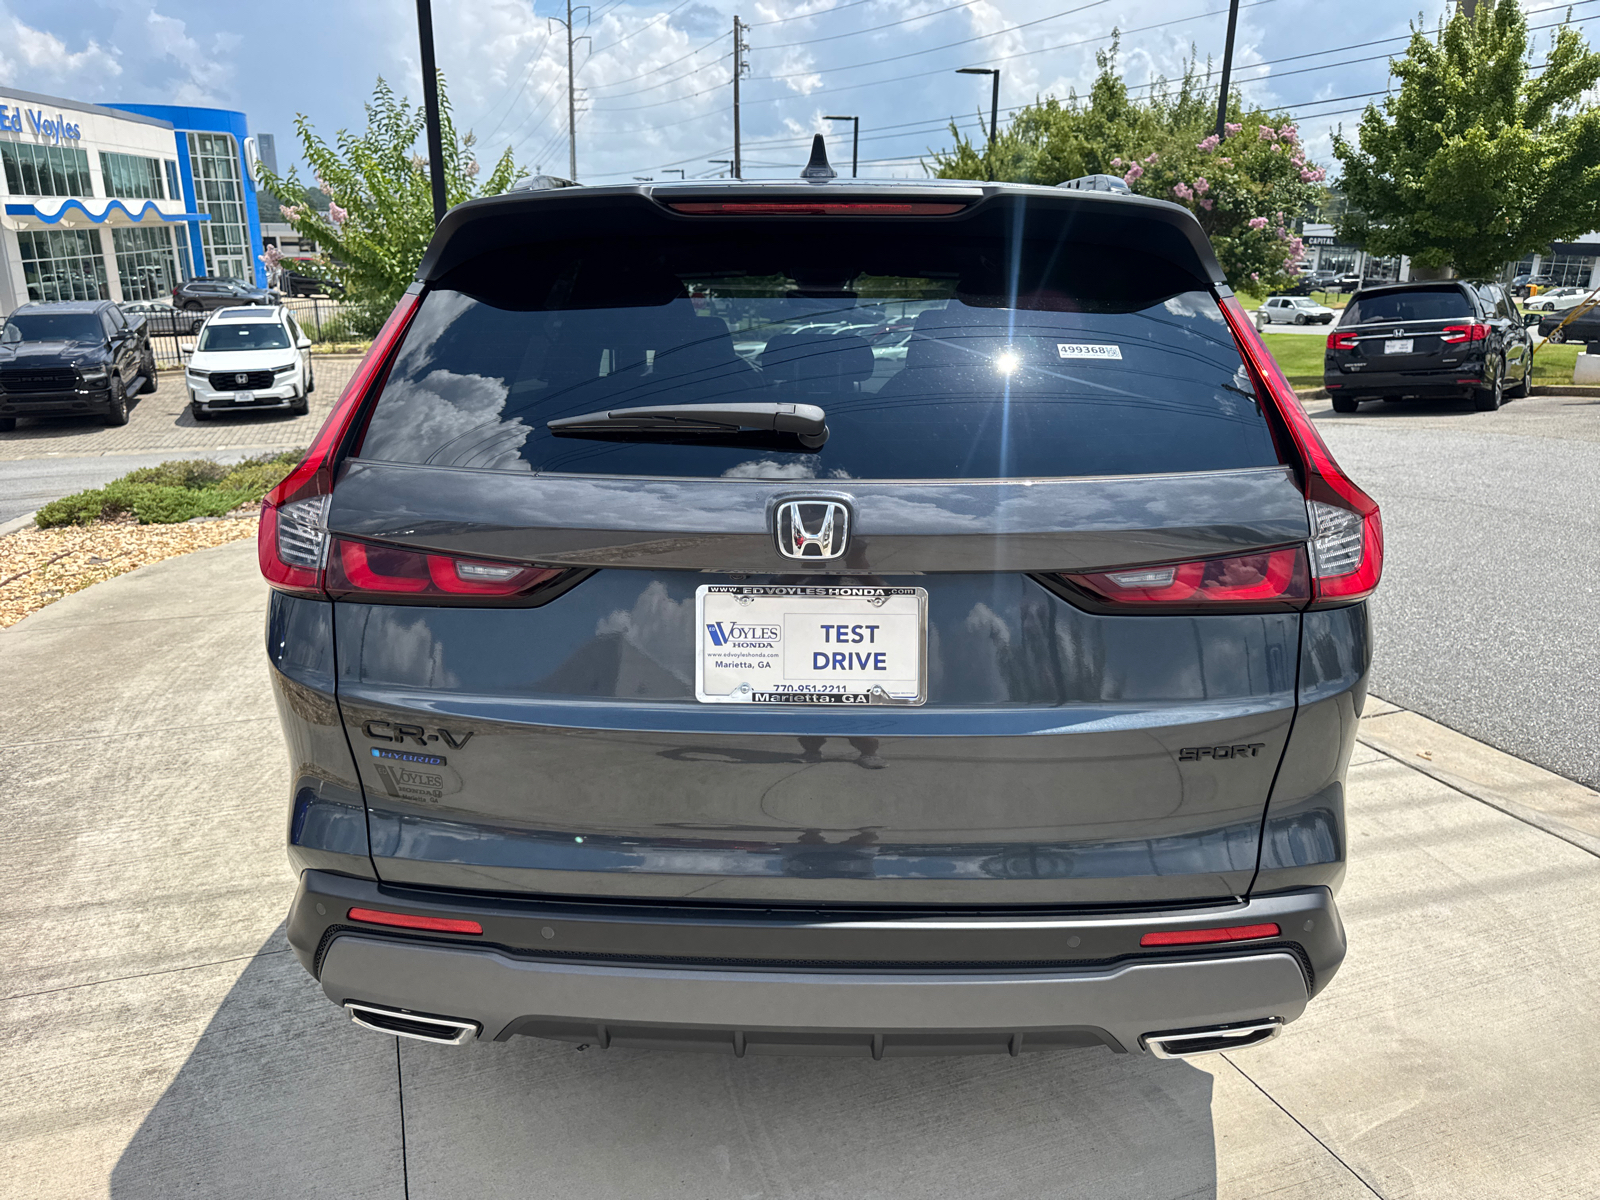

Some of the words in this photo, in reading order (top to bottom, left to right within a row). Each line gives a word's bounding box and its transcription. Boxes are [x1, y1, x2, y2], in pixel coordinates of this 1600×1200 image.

[0, 105, 23, 132] Ed
[28, 109, 81, 144] Voyles
[715, 621, 778, 644] VOYLES
[820, 624, 880, 644] TEST
[707, 651, 779, 659] www.edvoyleshonda.com
[715, 660, 755, 669] Marietta,
[757, 661, 771, 669] GA
[813, 651, 887, 671] DRIVE
[755, 693, 835, 703] Marietta,
[841, 694, 867, 703] GA
[773, 684, 847, 693] 770-951-2211
[362, 720, 474, 750] CR-V
[382, 752, 440, 765] HYBRID
[1178, 743, 1266, 762] SPORT
[388, 766, 442, 786] VOYLES
[398, 786, 433, 796] HONDA
